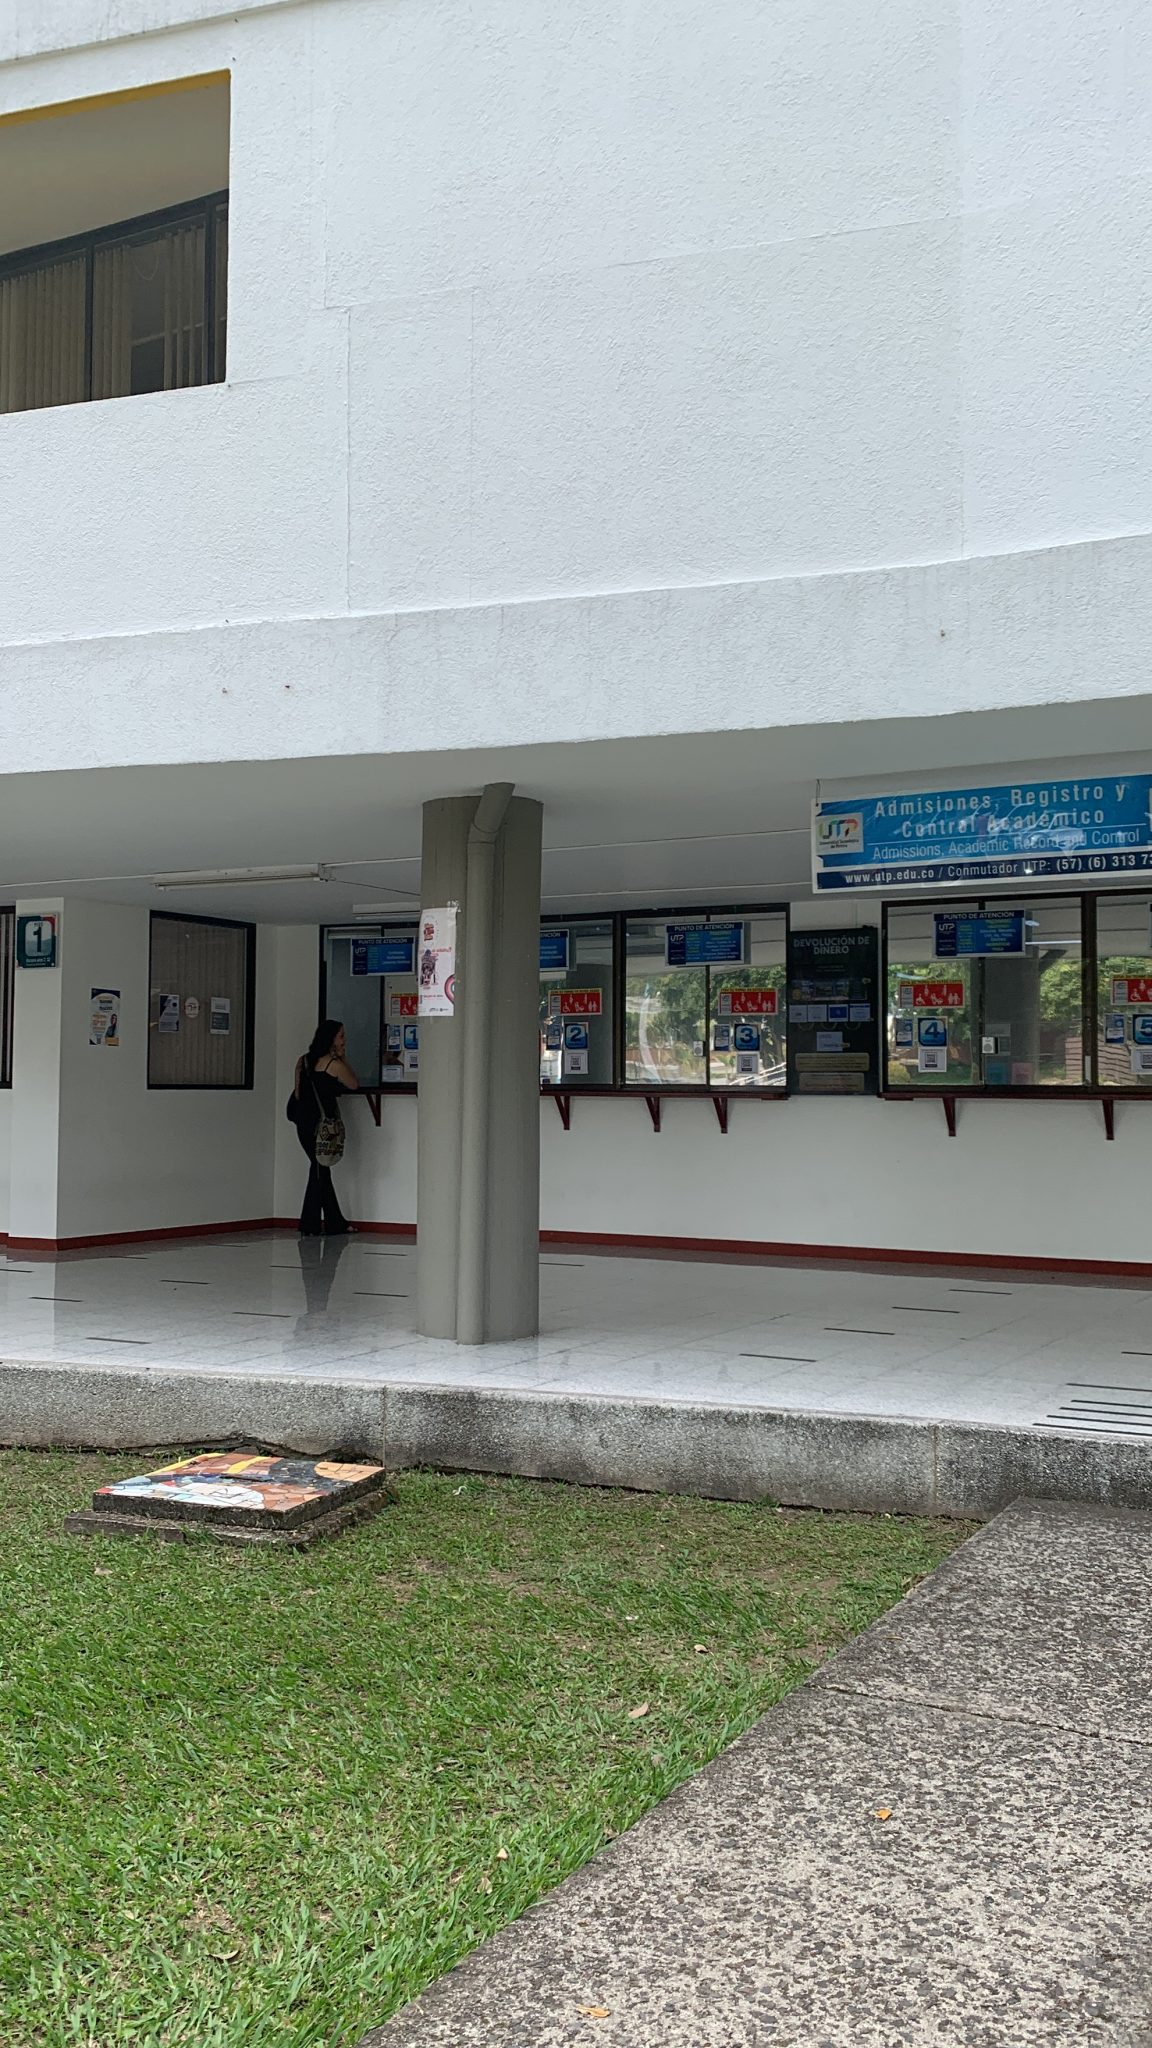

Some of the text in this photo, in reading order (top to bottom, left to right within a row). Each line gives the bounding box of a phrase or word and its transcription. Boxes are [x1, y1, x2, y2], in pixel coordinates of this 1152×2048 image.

[875, 784, 1126, 818] Admisiones, Registro y
[902, 808, 1104, 838] Control Académico
[873, 844, 945, 861] Admissions,
[948, 838, 1009, 855] Academic
[1013, 834, 1059, 851] Record
[1092, 827, 1140, 846] Control
[845, 869, 935, 884] www.utp.edu.co
[948, 859, 1018, 877] Conmutador
[1023, 860, 1051, 872] UTP:
[1056, 858, 1082, 872] (57)
[1089, 856, 1107, 871] (6)
[1112, 854, 1136, 867] 313
[33, 927, 42, 952] 1
[793, 935, 870, 948] DEVOLUCIÓN DE
[814, 945, 850, 955] DINERO
[570, 1026, 582, 1042] 2
[740, 1027, 754, 1043] 3
[925, 1021, 941, 1038] 4
